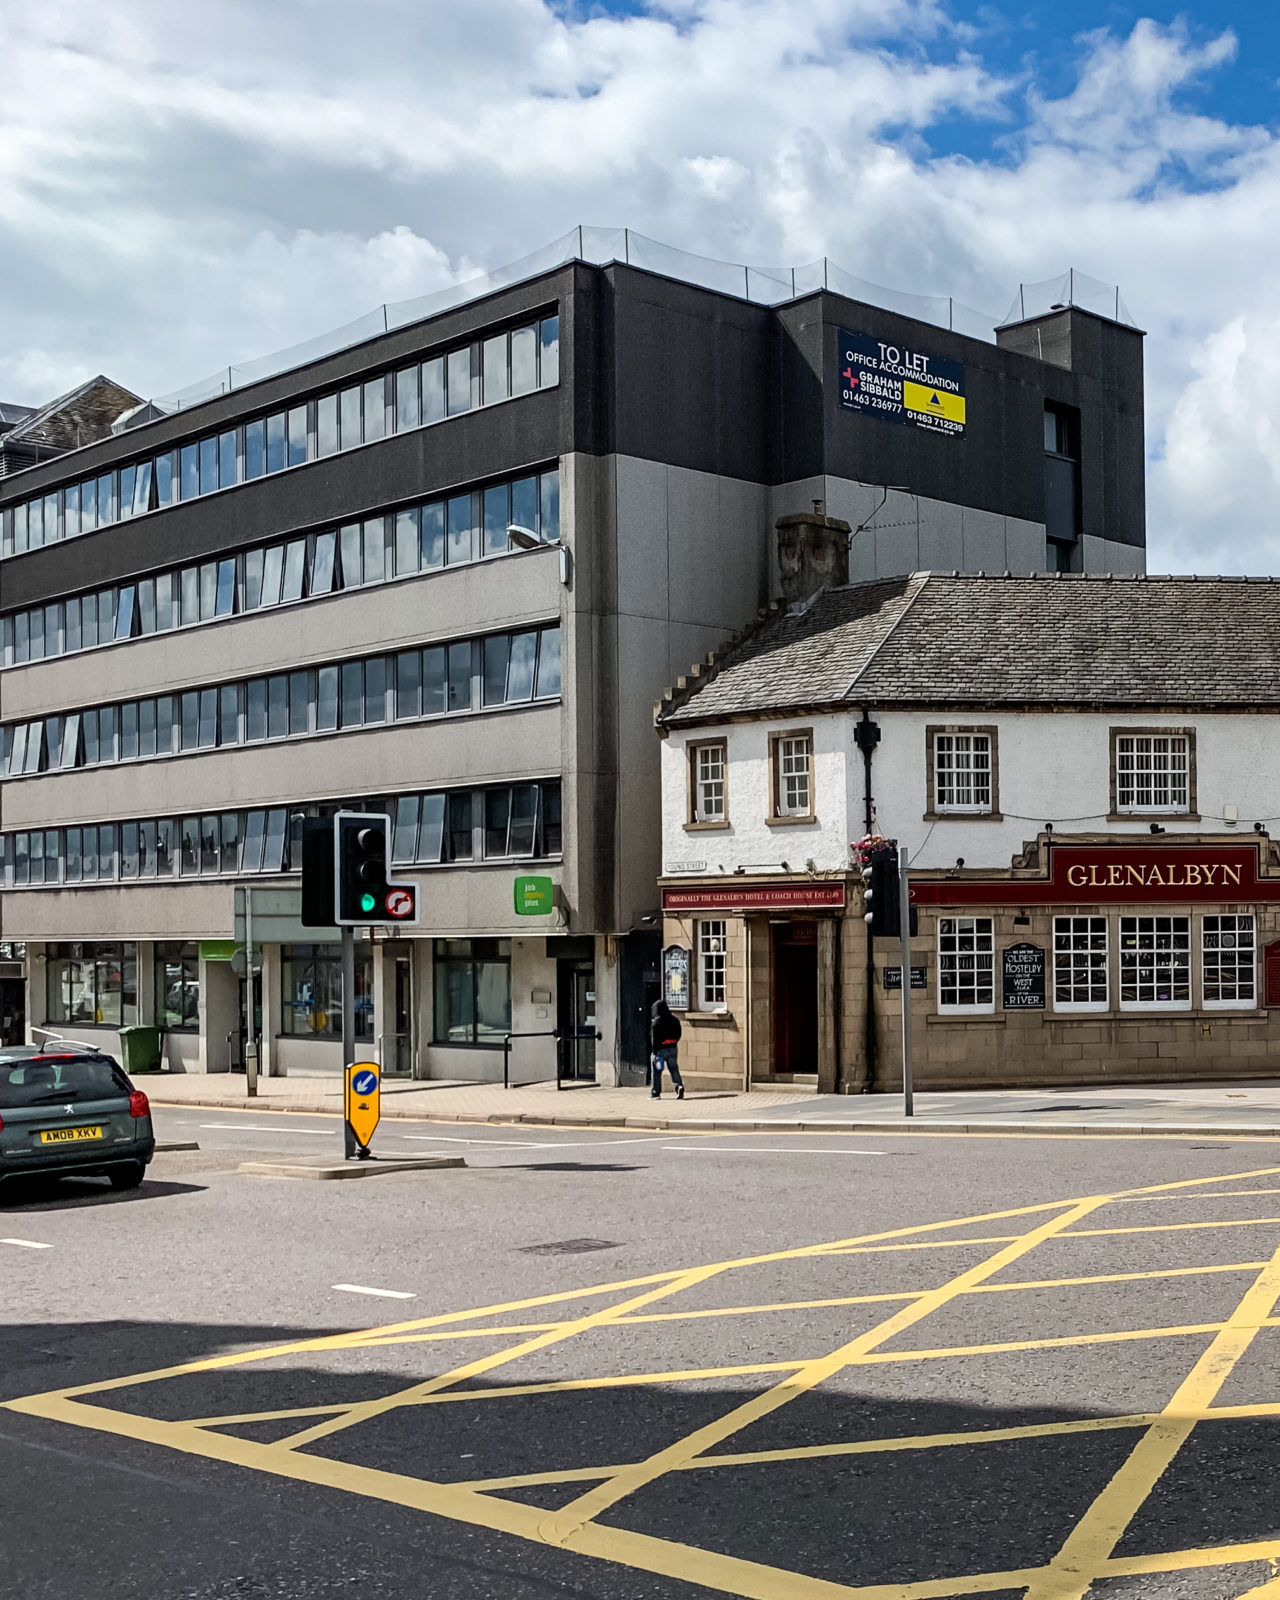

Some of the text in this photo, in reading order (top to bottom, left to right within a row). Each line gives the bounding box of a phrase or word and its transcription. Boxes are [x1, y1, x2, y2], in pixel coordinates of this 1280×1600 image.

[878, 342, 930, 372] TO LET
[846, 350, 959, 392] OFFICE ACCOMMODATION
[860, 372, 902, 391] GRAHAM
[860, 382, 902, 400] SIBBALD
[843, 390, 870, 405] 01463
[872, 398, 902, 414] 236977
[907, 410, 964, 432] 01463 712239
[1067, 864, 1242, 886] GLENALBYN
[525, 883, 536, 892] job
[1006, 963, 1042, 973] HOSTELRY
[1010, 996, 1040, 1004] RIVER
[46, 1128, 97, 1141] AM08 XKV
